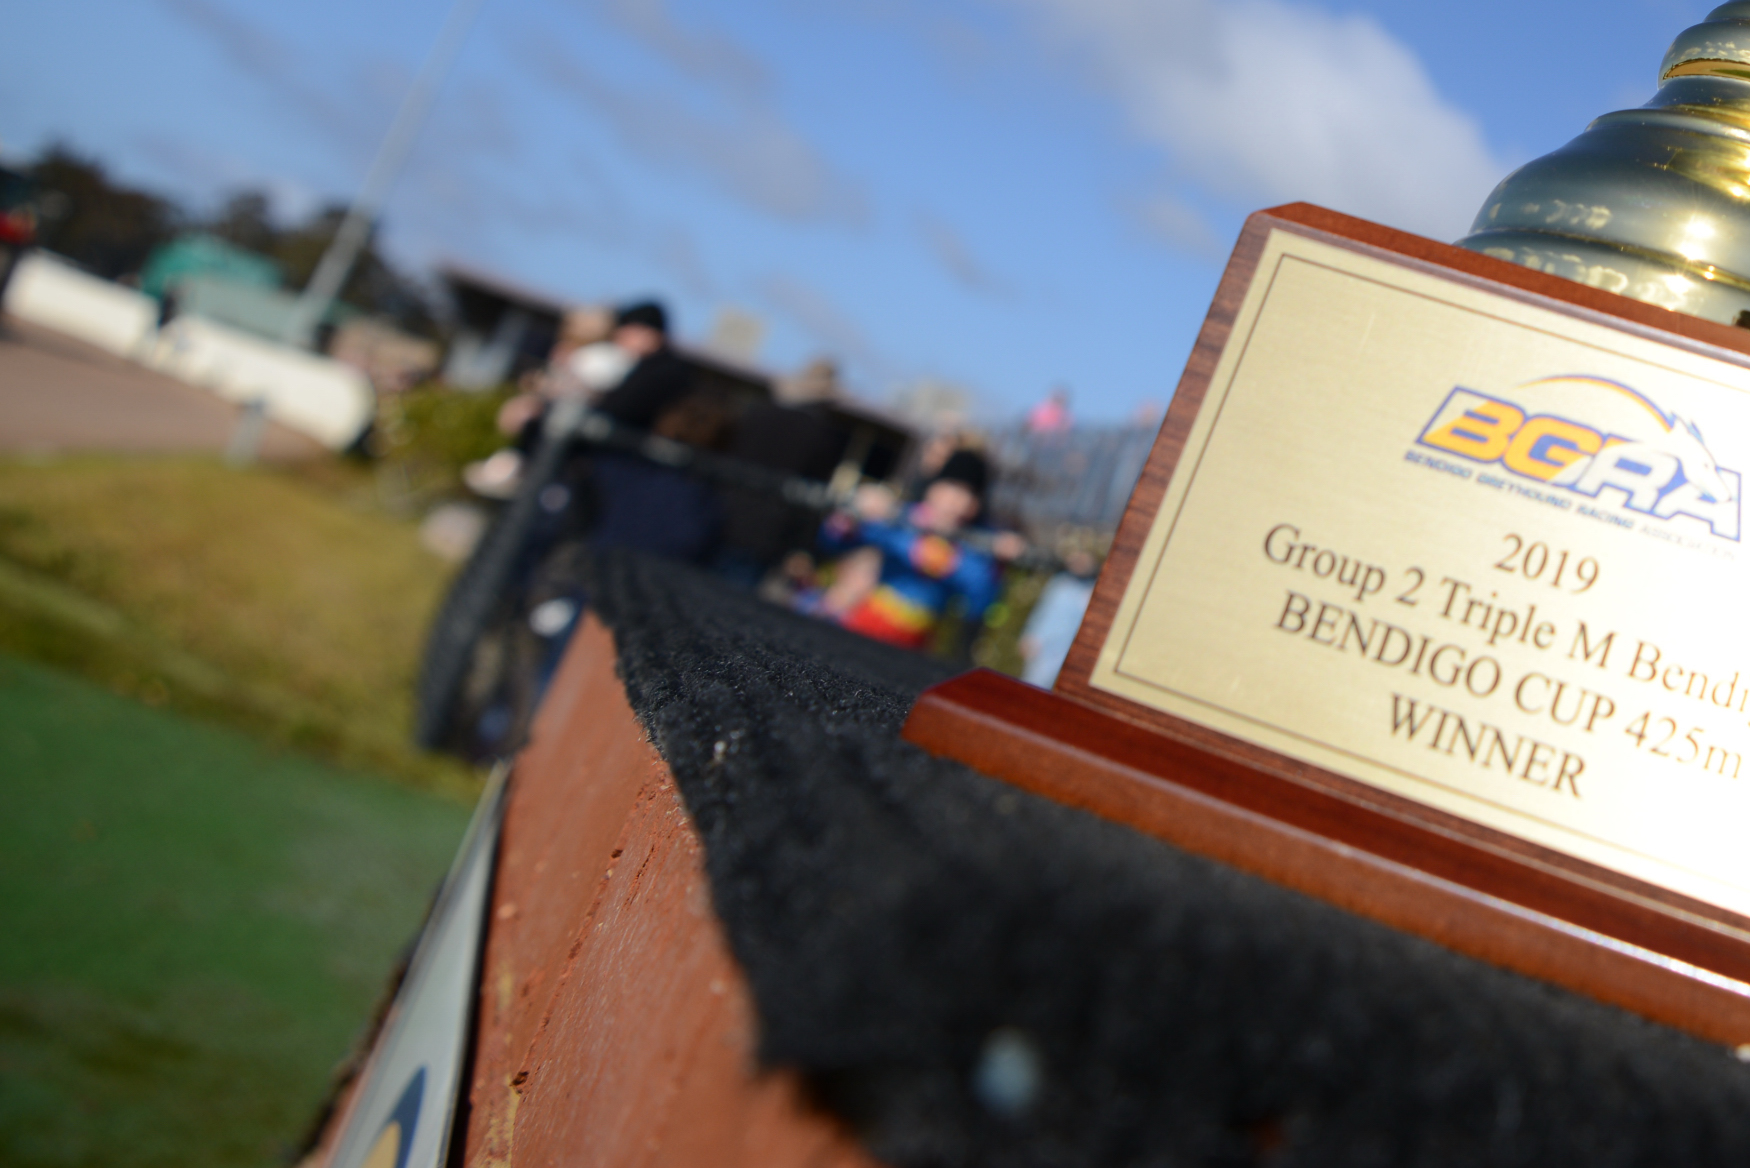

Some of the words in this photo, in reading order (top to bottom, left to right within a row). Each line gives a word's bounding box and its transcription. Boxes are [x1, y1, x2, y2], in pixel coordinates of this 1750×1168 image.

[1404, 449, 1473, 479] BENDIGO
[1575, 503, 1636, 530] RACING
[1415, 385, 1742, 543] BGRA
[1263, 522, 1387, 603] Group
[1396, 566, 1426, 607] 2
[1440, 576, 1557, 649] Triple
[1567, 619, 1619, 669] M
[1494, 533, 1600, 595] 2019
[1273, 588, 1502, 699] BENDIGO
[1514, 671, 1616, 733] CUP
[1625, 710, 1743, 779] 425m
[1390, 692, 1587, 800] WINNER
